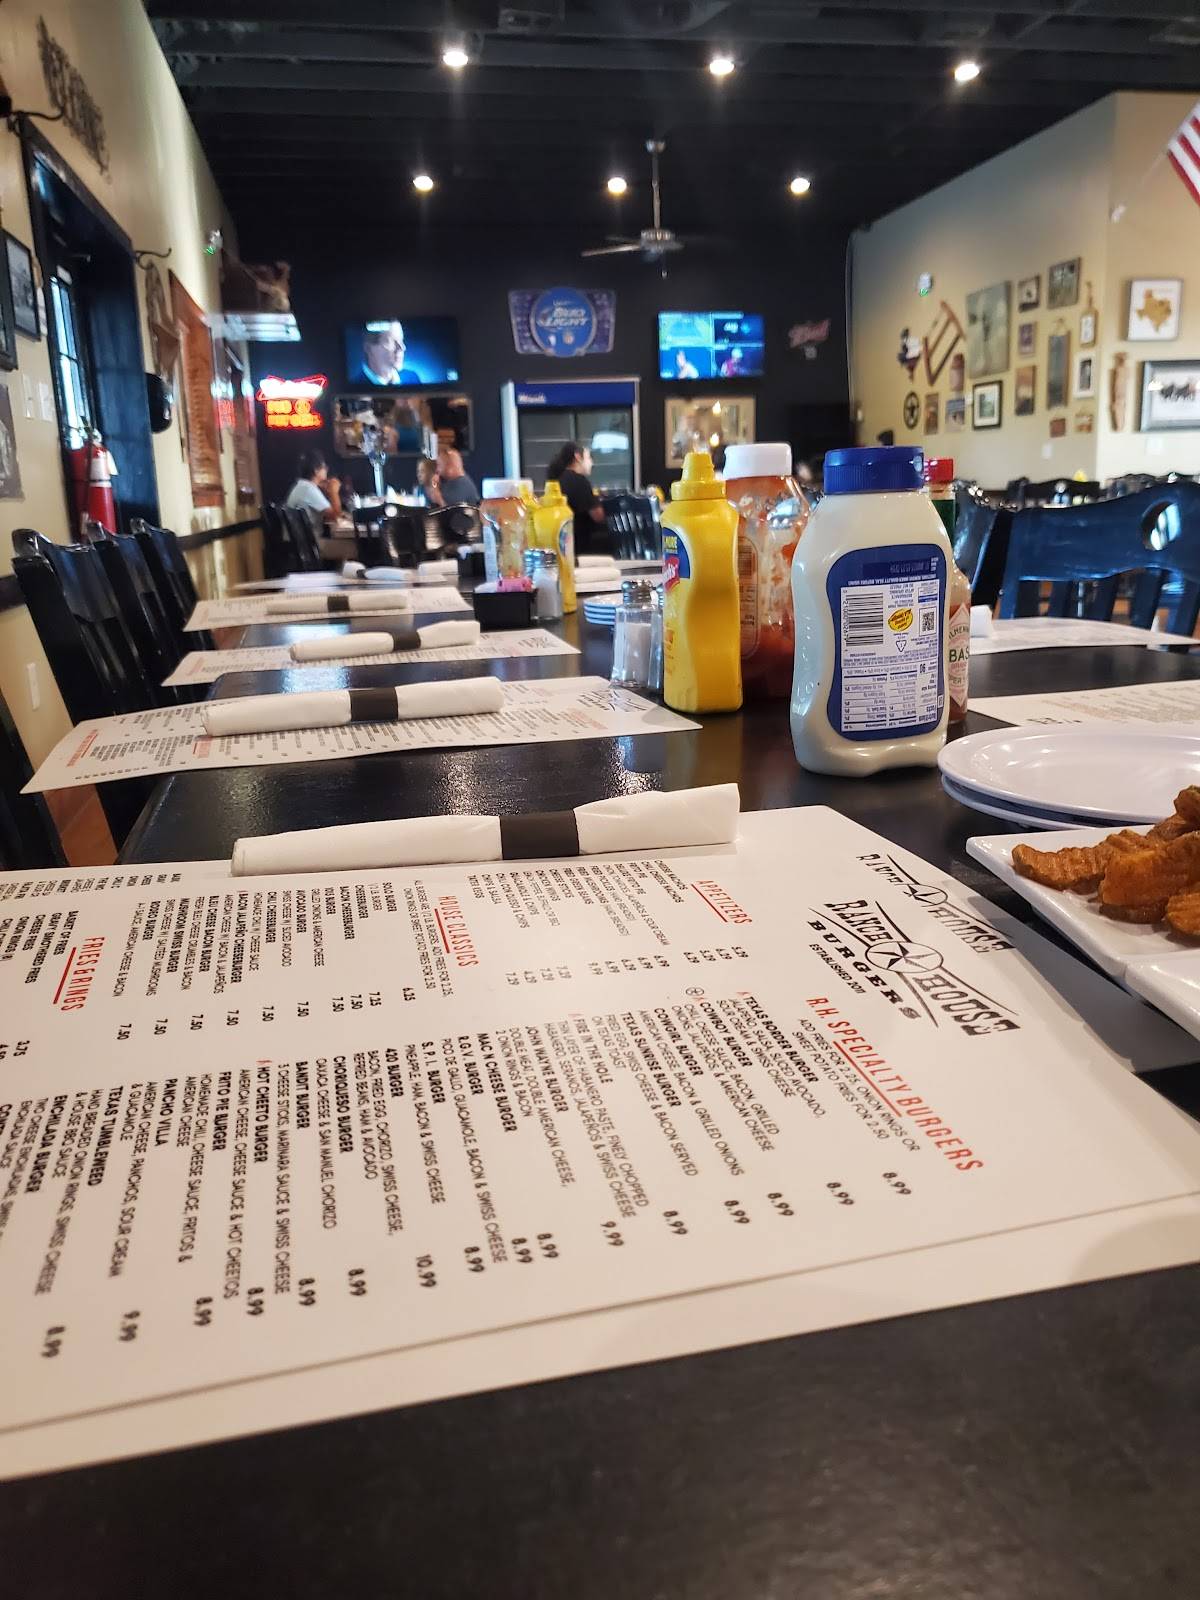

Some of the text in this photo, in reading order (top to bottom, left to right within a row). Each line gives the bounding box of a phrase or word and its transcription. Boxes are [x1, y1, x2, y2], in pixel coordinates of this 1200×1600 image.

[63, 910, 79, 930] BASKET
[237, 893, 249, 911] BACON
[654, 859, 673, 874] CHEESE
[667, 873, 688, 890] NACHOS
[699, 880, 752, 924] APPETIZERS
[22, 914, 46, 951] CHEESE FRIES
[24, 912, 62, 984] GRAVY SMOTHERED FRIES
[53, 939, 69, 956] FRIES
[76, 937, 105, 966] FRIES
[116, 900, 161, 1040] RODEO BURGER 7.50
[153, 898, 190, 1035] MUSHROOM SWISS BURGER 7.50
[190, 895, 220, 1031] BLEU CHEESE BACON BURGER 7.50
[230, 938, 245, 984] CHEESEBURGER
[262, 891, 278, 1022] CHILI CHEESEBURGER 7.50
[295, 889, 310, 1017] AVOCADO BURGER 7.50
[339, 886, 363, 1010] BACON CHEESEBURGER 7.50
[355, 884, 382, 1007] CHEESEBURGER 7.25
[382, 882, 416, 1001] SOLO BURGER 6.25
[439, 895, 479, 967] HOUSE CLASSICS
[807, 919, 922, 1020] BURGERS
[809, 943, 867, 994] ESTABLISHED 2011
[824, 899, 1021, 1036] RANCH HOUSE
[61, 976, 93, 1011] RINGS
[226, 1009, 240, 1026] 7.50
[332, 996, 345, 1013] 7.50
[477, 1033, 493, 1052] MAC
[13, 1040, 30, 1057] 3.75
[315, 1058, 329, 1089] OAXACA
[485, 1061, 506, 1094] CHEESE
[746, 996, 912, 1195] TEXAS BORDER BURGER 8.99
[792, 1031, 890, 1139] SWEET POTATO FRIES FOR 2.50
[828, 1021, 907, 1092] SPECIALTY
[897, 1097, 983, 1171] BURGERS
[26, 1095, 68, 1193] ENCHILADA BURGER
[176, 1076, 197, 1147] AMERICAN CHEESE
[317, 1089, 331, 1120] CHEESE
[318, 1129, 332, 1146] SAN
[458, 1035, 533, 1264] R.G.V. BURGER 8.99
[495, 1095, 517, 1132] BURGER
[525, 1026, 624, 1247] JOHN WAYNE BURGER 9.99
[574, 1018, 688, 1235] FIRE IN THE HOLE 8.99
[622, 1012, 750, 1224] TEXAS SUNRISE BURGER 8.99
[654, 1008, 794, 1216] COWGIRL BURGER 8.99
[699, 1002, 854, 1206] COWBOY BURGER 8.99
[119, 1078, 178, 1342] PANCHO VILLA 9.99
[194, 1071, 232, 1327] FRITO PIE BURGER 8.99
[247, 1066, 270, 1316] HOT CHEETO BURGER 8.99
[295, 1061, 316, 1307] BANDIT BURGER 8.99
[320, 1148, 334, 1182] MANUEL
[321, 1184, 337, 1229] CHORIZO
[333, 1055, 367, 1297] CHORIQUESO BURGER 8.99
[385, 1048, 437, 1288] 420 BURGER 10.99
[427, 1070, 446, 1104] BURGER
[464, 1246, 485, 1273] 8.99
[42, 1086, 124, 1358] TEXAS TUMBLEWEED 8.99
[537, 1233, 559, 1259] 8.99
